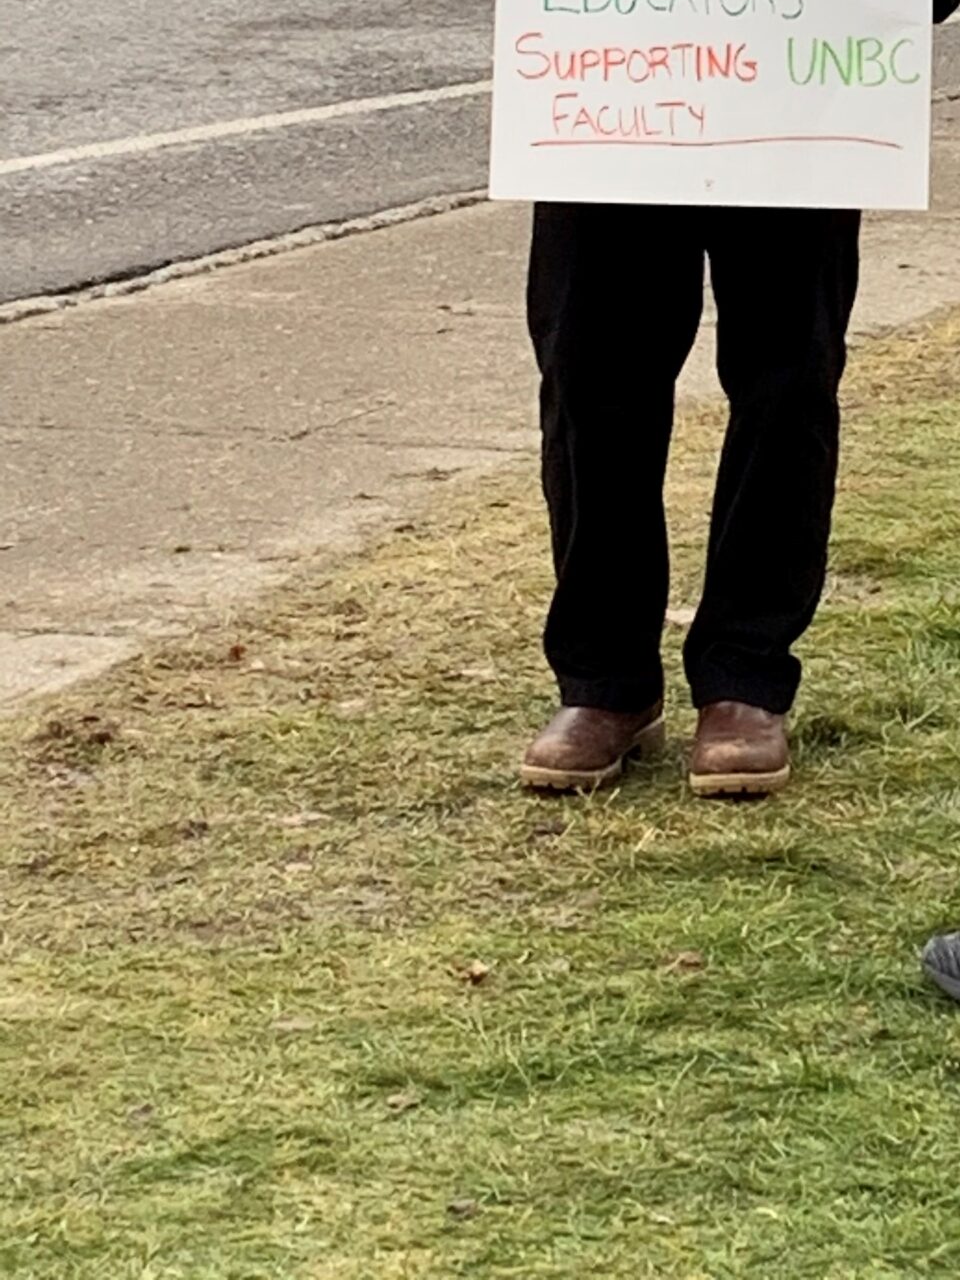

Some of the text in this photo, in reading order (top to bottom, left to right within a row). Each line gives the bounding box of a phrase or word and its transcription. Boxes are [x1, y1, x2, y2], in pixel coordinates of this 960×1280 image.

[516, 32, 921, 87] SUPPORTING UNBC
[552, 92, 707, 138] FACULTY
